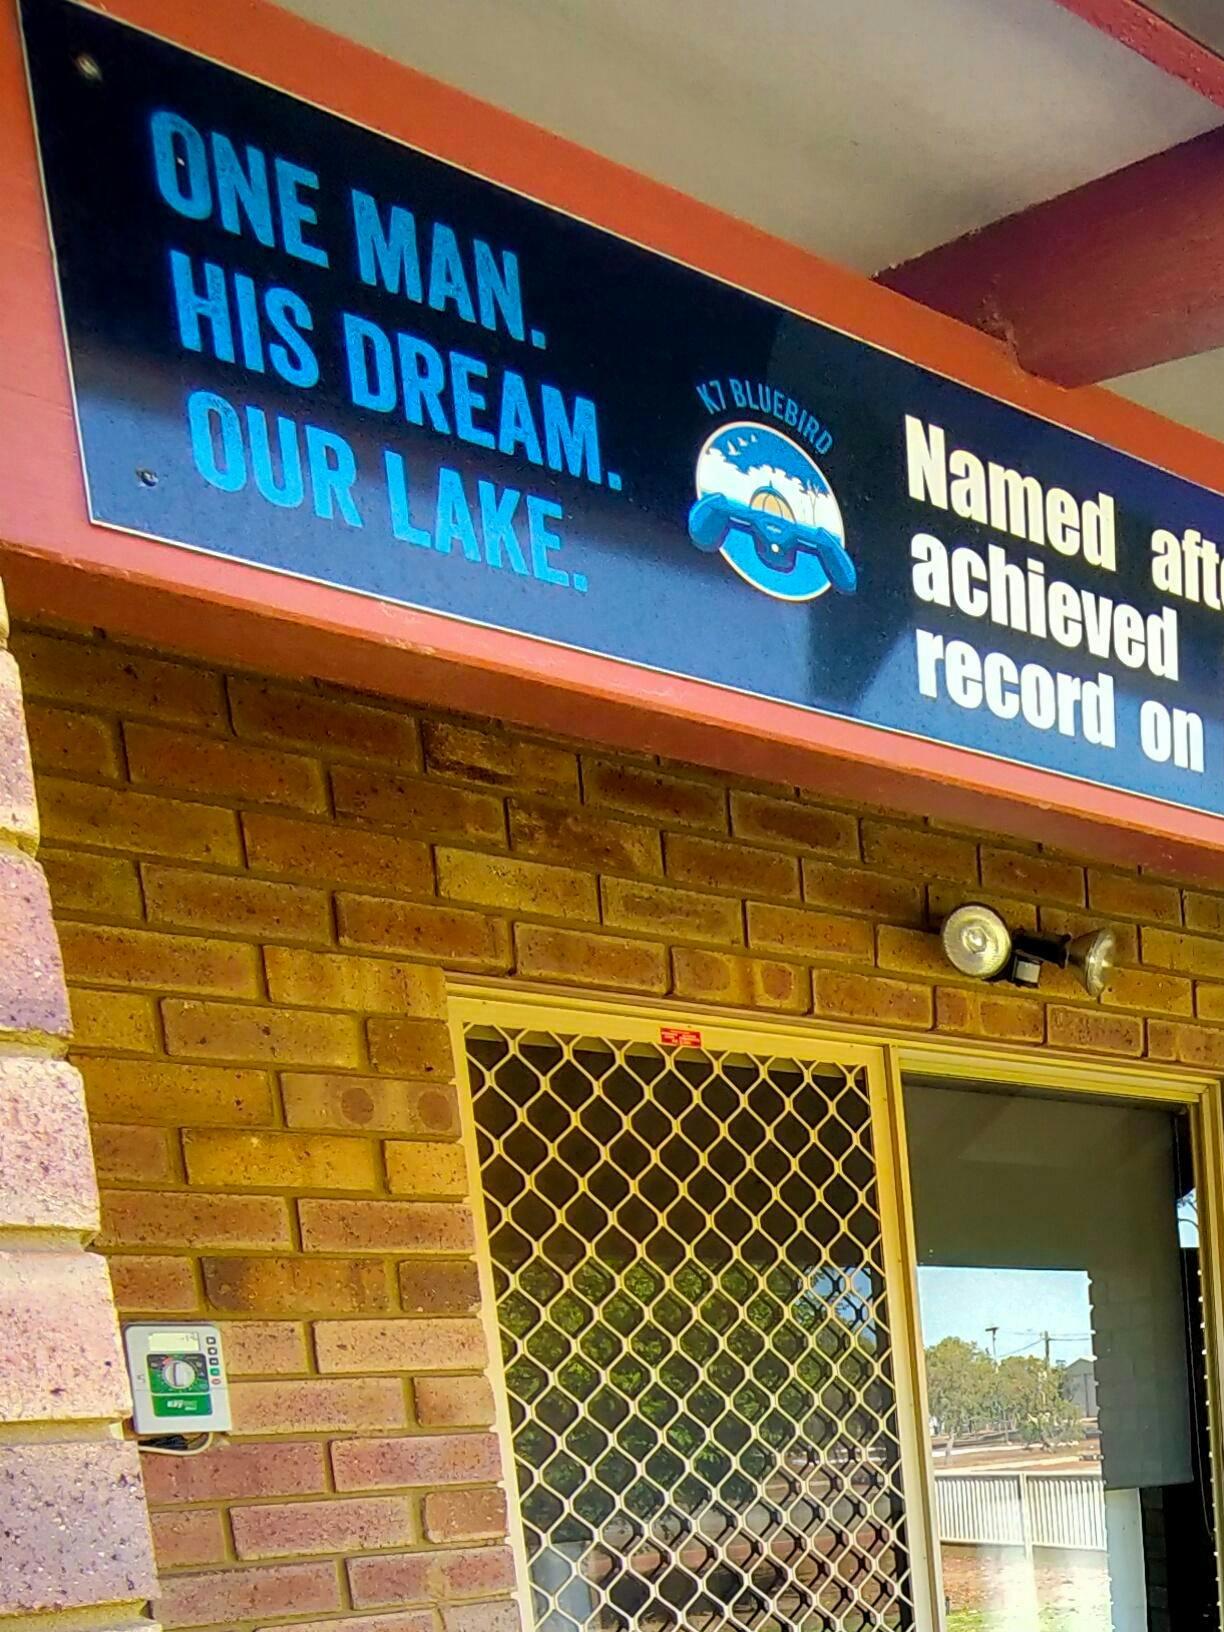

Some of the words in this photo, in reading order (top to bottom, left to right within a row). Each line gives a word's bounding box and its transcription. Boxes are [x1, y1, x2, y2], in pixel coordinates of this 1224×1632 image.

[150, 111, 328, 269] ONE
[351, 187, 547, 351] MAN.
[170, 250, 320, 390] HIS
[343, 310, 623, 492] DREAM.
[696, 379, 727, 415] K7
[729, 378, 834, 455] BLUEBIRD
[187, 391, 363, 528] OUR
[384, 450, 589, 594] LAKE.
[905, 414, 1116, 572] Named
[911, 533, 1179, 682] achieved
[916, 628, 1116, 749] record
[1140, 700, 1204, 774] on
